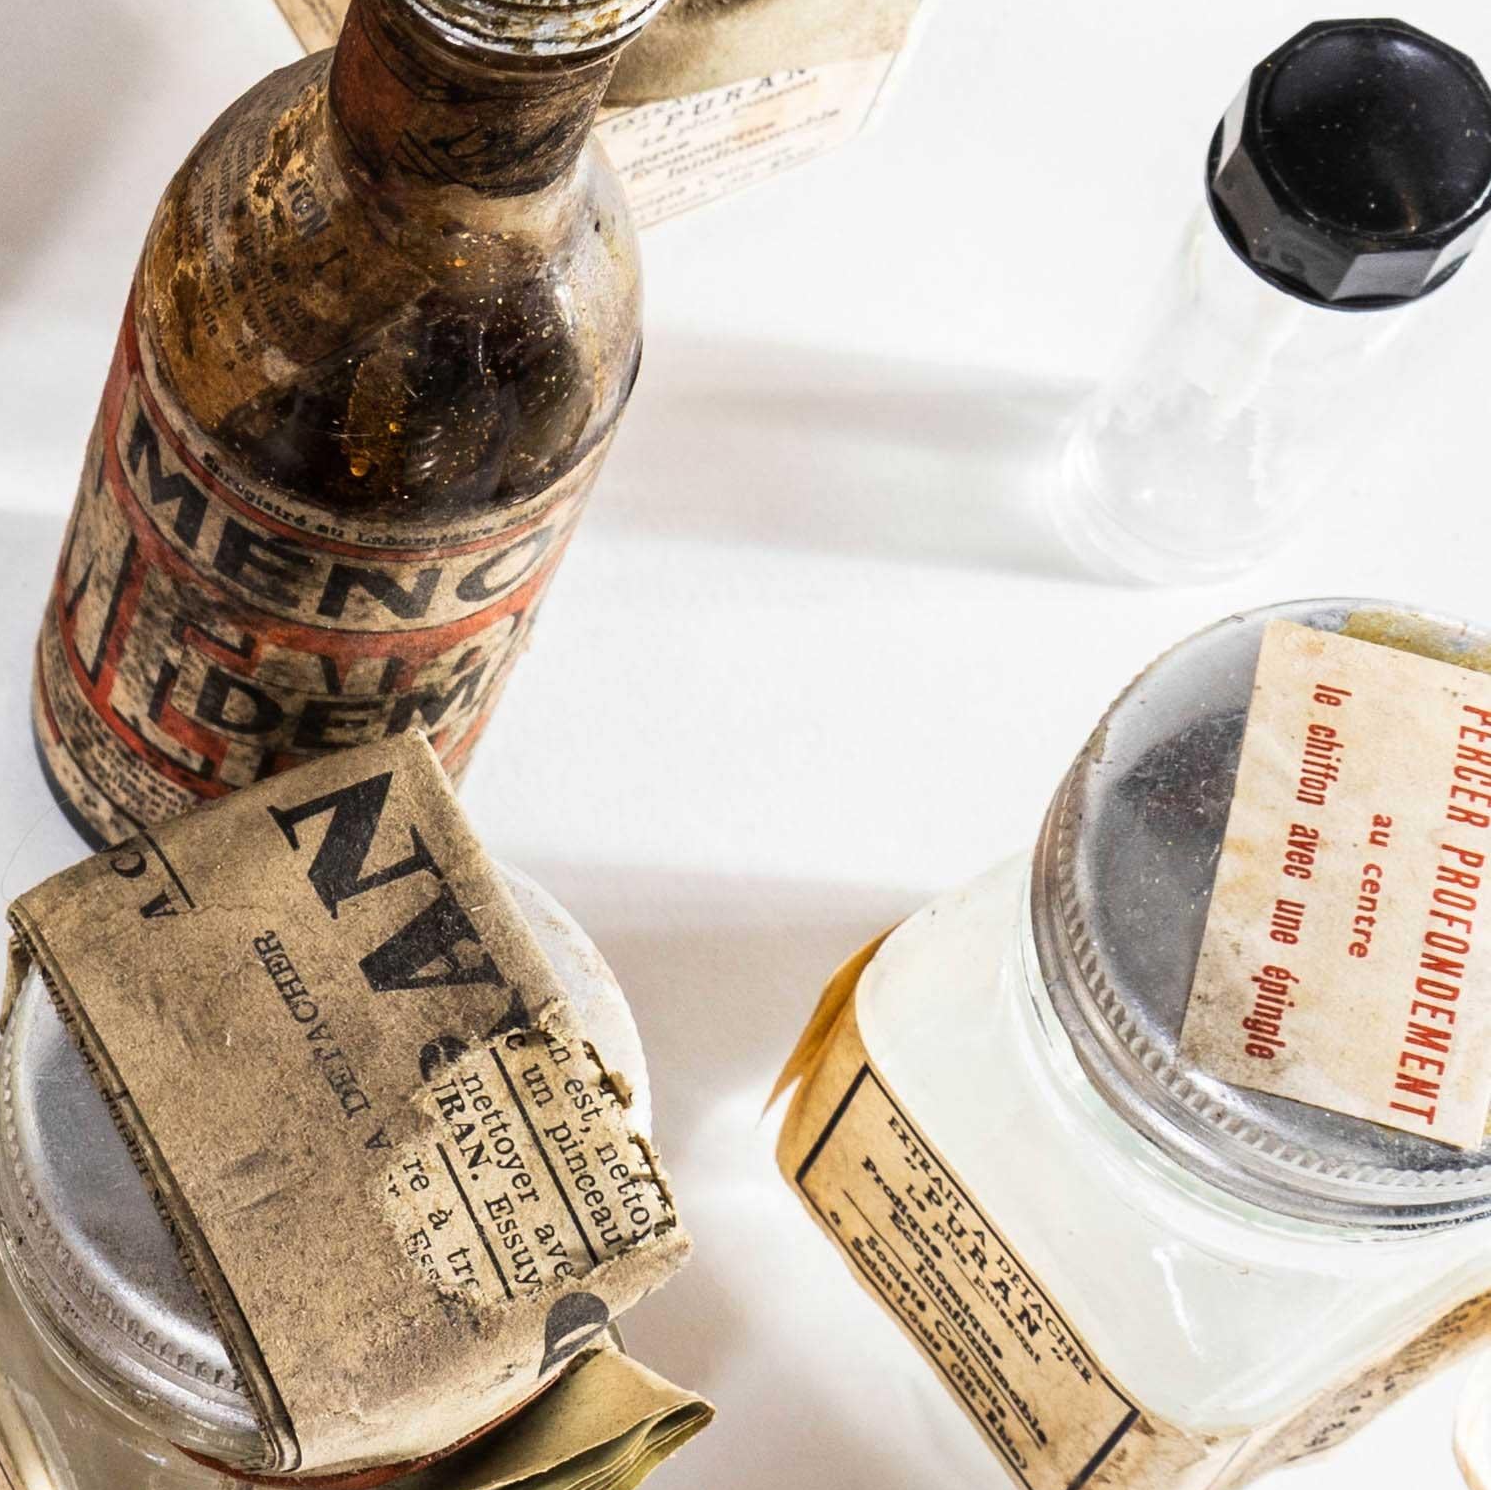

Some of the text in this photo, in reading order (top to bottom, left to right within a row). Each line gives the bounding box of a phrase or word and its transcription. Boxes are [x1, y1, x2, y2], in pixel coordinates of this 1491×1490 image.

[140, 890, 180, 921] A
[1242, 683, 1352, 1060] le chiffon avec une épingle
[1348, 813, 1393, 959] au centre
[252, 930, 392, 1150] A DETACHER
[1388, 842, 1485, 1126] PROFONDEMENT
[453, 1072, 539, 1202] nettoyer
[521, 1063, 554, 1108] un
[544, 1121, 635, 1246] pinceau
[563, 1078, 603, 1133] est,
[426, 1208, 453, 1231] à
[483, 1192, 542, 1293] Essuy
[862, 1156, 942, 1258] Pratique
[887, 1116, 964, 1211] EXTRAIT
[971, 1229, 986, 1247] A
[865, 1235, 1006, 1418] Société Cellonite
[890, 1210, 1002, 1358] Economique
[905, 1183, 1041, 1363] Le plus puissant
[915, 1263, 1046, 1443] Ininflammable
